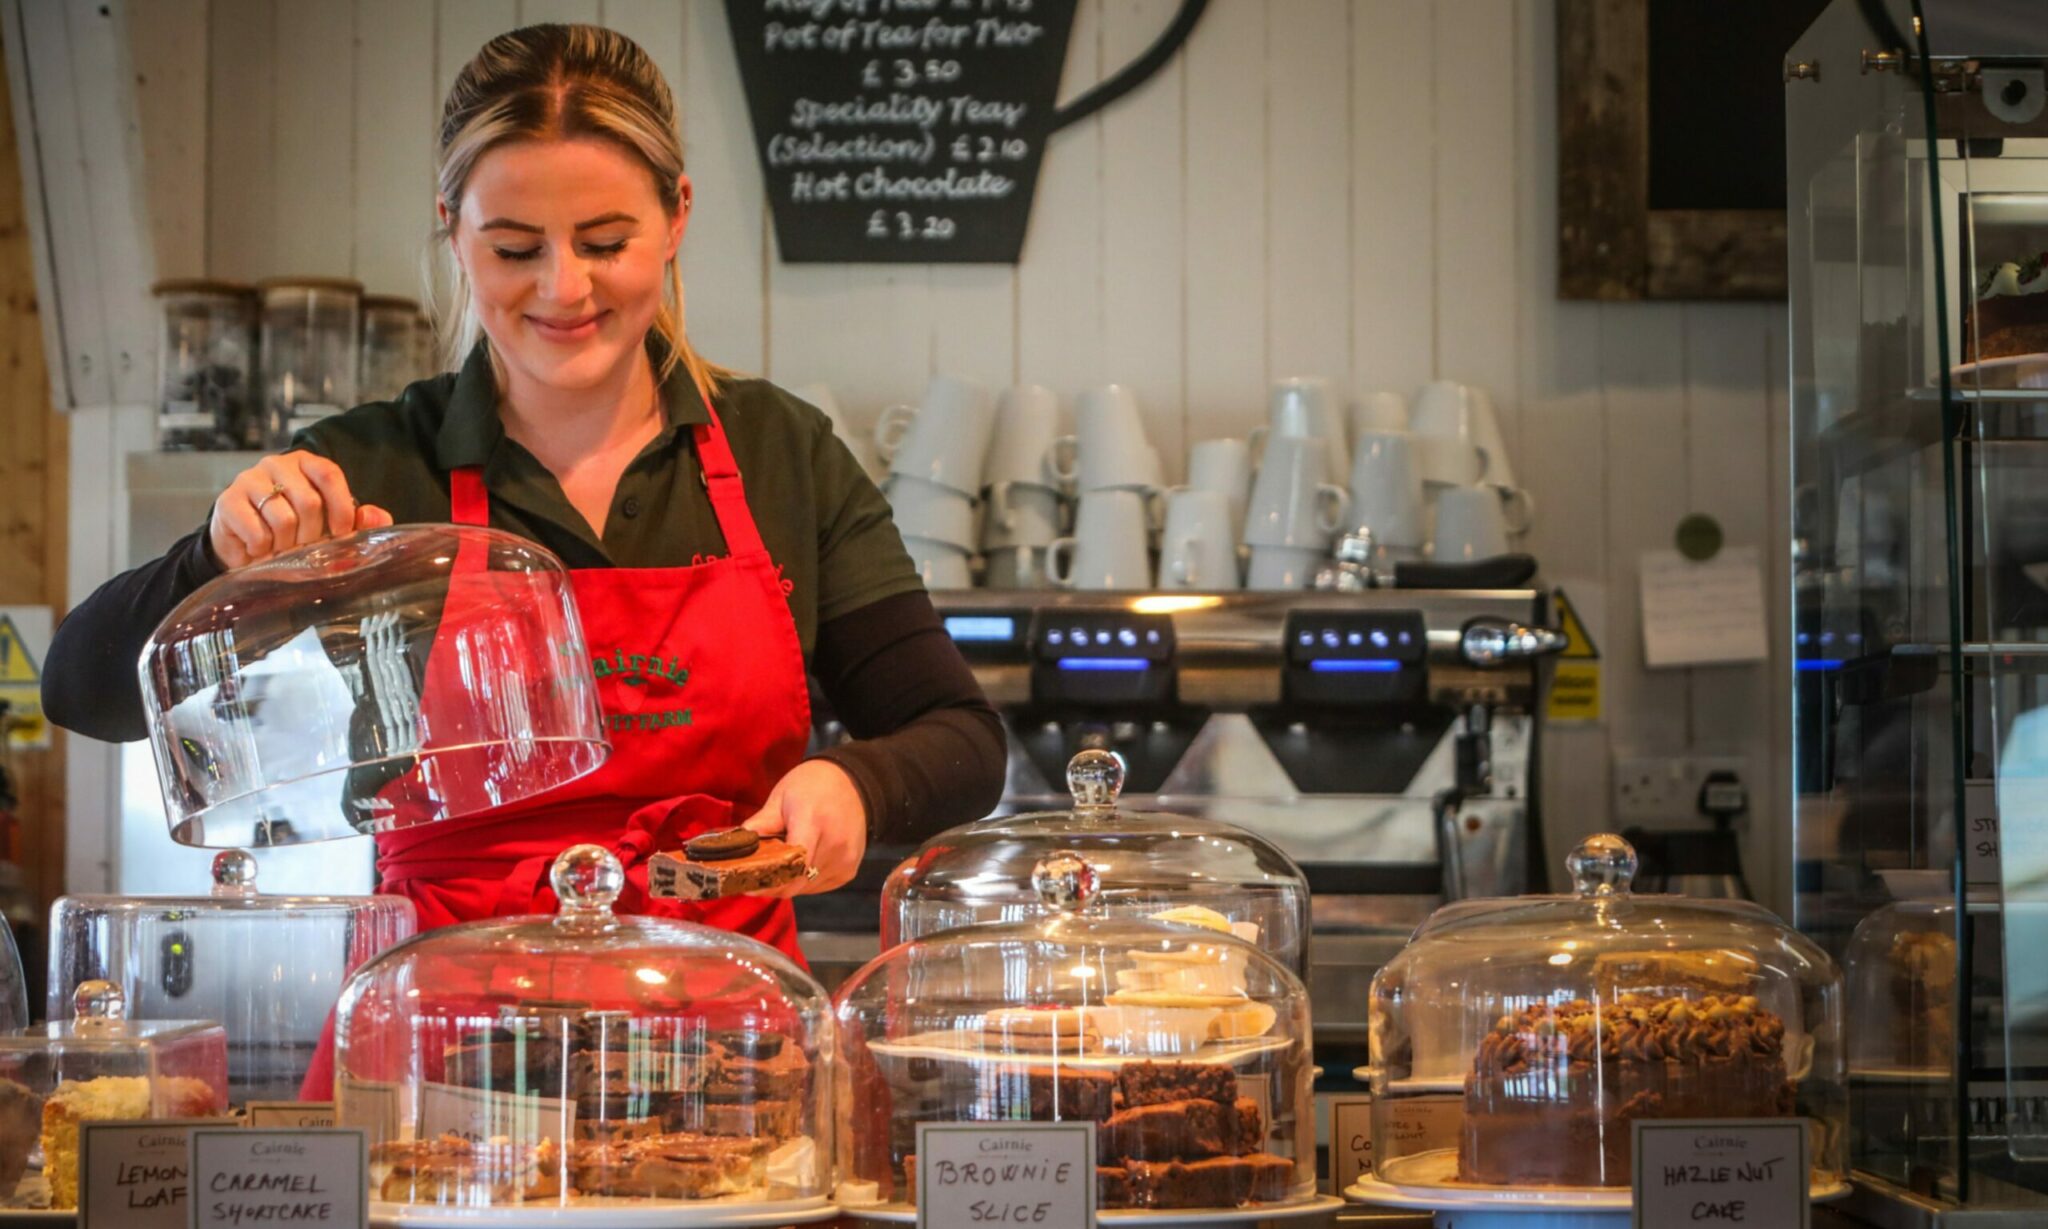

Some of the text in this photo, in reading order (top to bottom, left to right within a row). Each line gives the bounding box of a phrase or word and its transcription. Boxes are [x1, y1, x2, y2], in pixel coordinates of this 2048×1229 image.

[765, 16, 1043, 51] Pot of Tea for Two
[791, 94, 1025, 129] Speciality Teas
[769, 132, 936, 166] (Selection)
[792, 166, 1015, 200] Hot Chocolate
[638, 708, 693, 730] FARM
[252, 1141, 305, 1157] Cairnie
[978, 1138, 1033, 1152] Cairnie
[1694, 1135, 1748, 1150] Cairnie
[116, 1162, 188, 1187] LEMON
[210, 1172, 326, 1194] CARAMEL
[1691, 1201, 1745, 1222] CAKE
